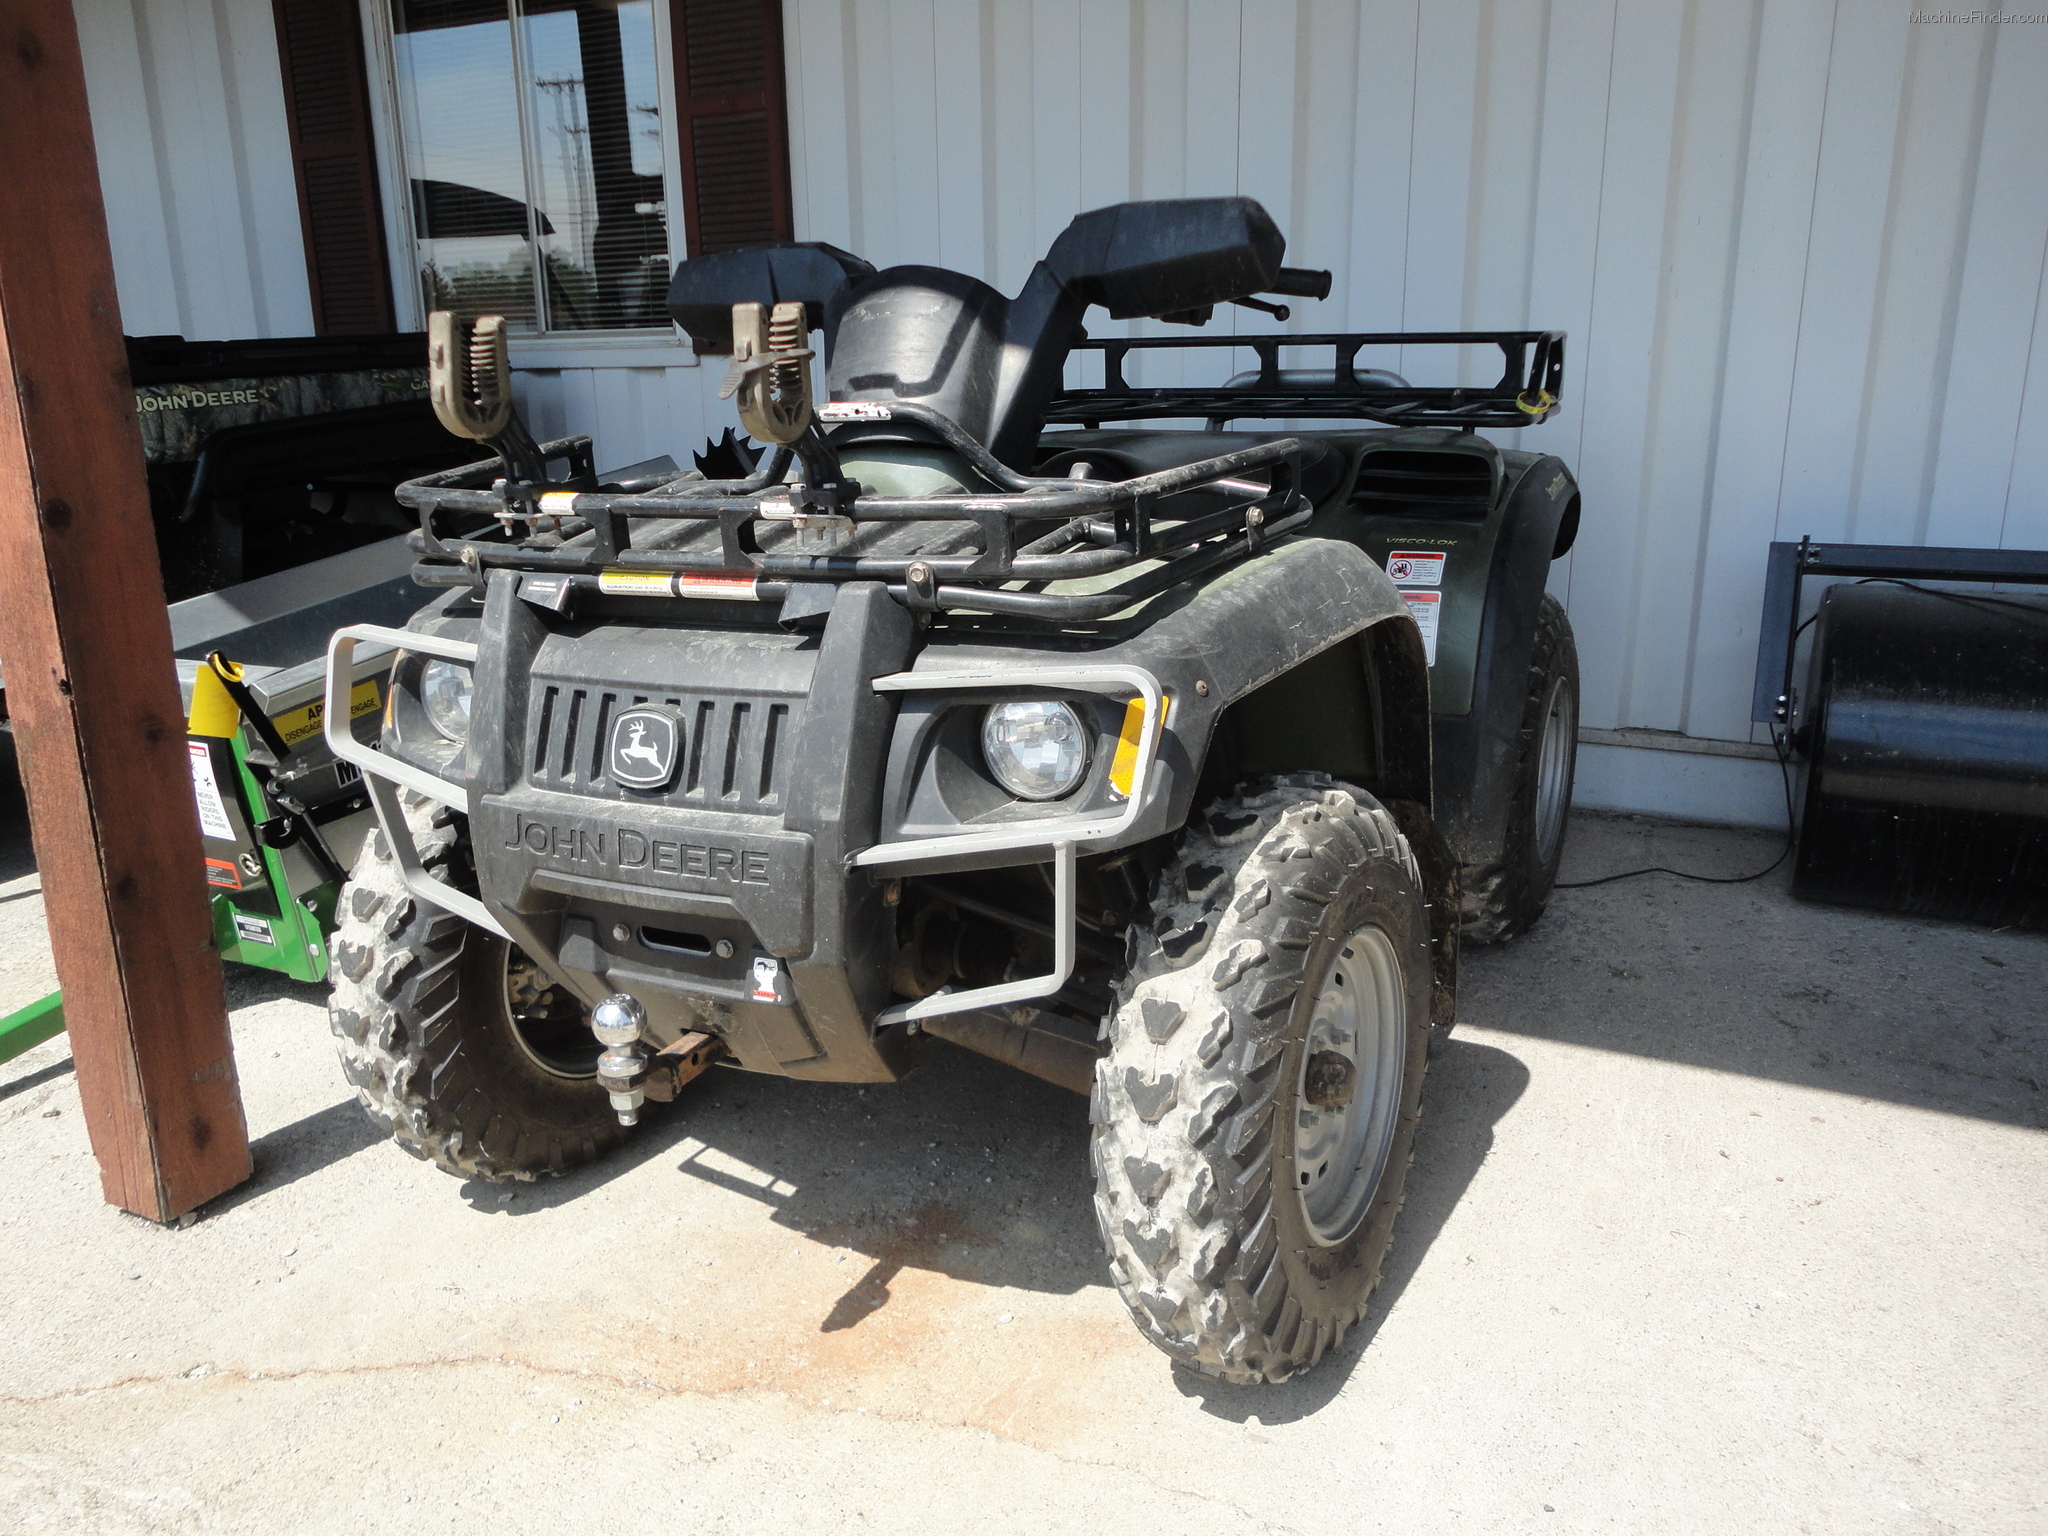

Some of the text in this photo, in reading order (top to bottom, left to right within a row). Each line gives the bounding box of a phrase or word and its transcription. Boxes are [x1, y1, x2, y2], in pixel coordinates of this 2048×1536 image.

[135, 389, 259, 413] JOHN DEERE
[307, 702, 325, 720] AP
[284, 719, 323, 742] DISENGAGE
[505, 813, 770, 886] JOHN DEERE
